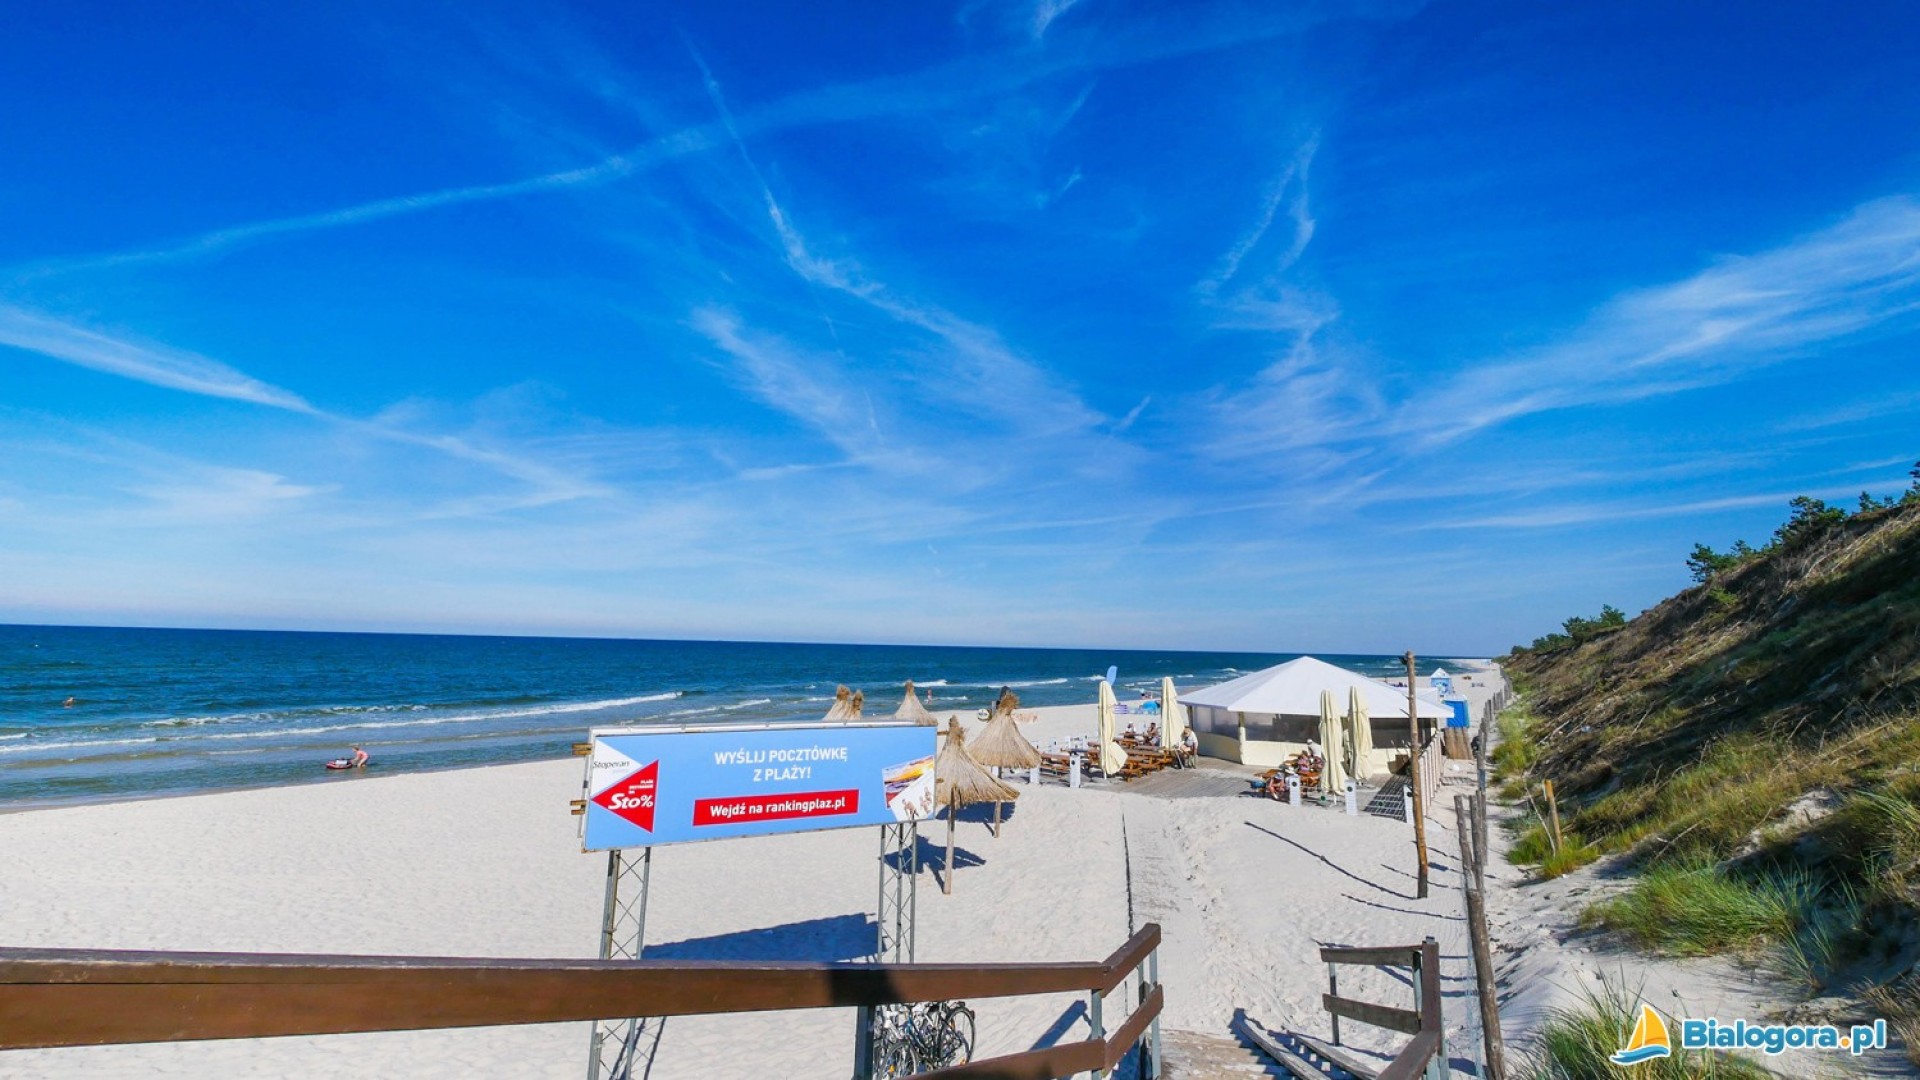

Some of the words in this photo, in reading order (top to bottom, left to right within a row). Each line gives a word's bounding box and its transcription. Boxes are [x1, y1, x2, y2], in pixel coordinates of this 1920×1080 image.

[714, 747, 766, 765] WYŚLIJ
[769, 744, 848, 763] POCZTÓWKĘ
[592, 760, 629, 769] Stoperan
[753, 769, 762, 782] Z
[765, 765, 811, 781] PLAŻY!
[607, 793, 653, 809] Sto%
[710, 802, 746, 819] Wejdź
[749, 805, 763, 815] na
[765, 797, 847, 814] rankingplaz.pl
